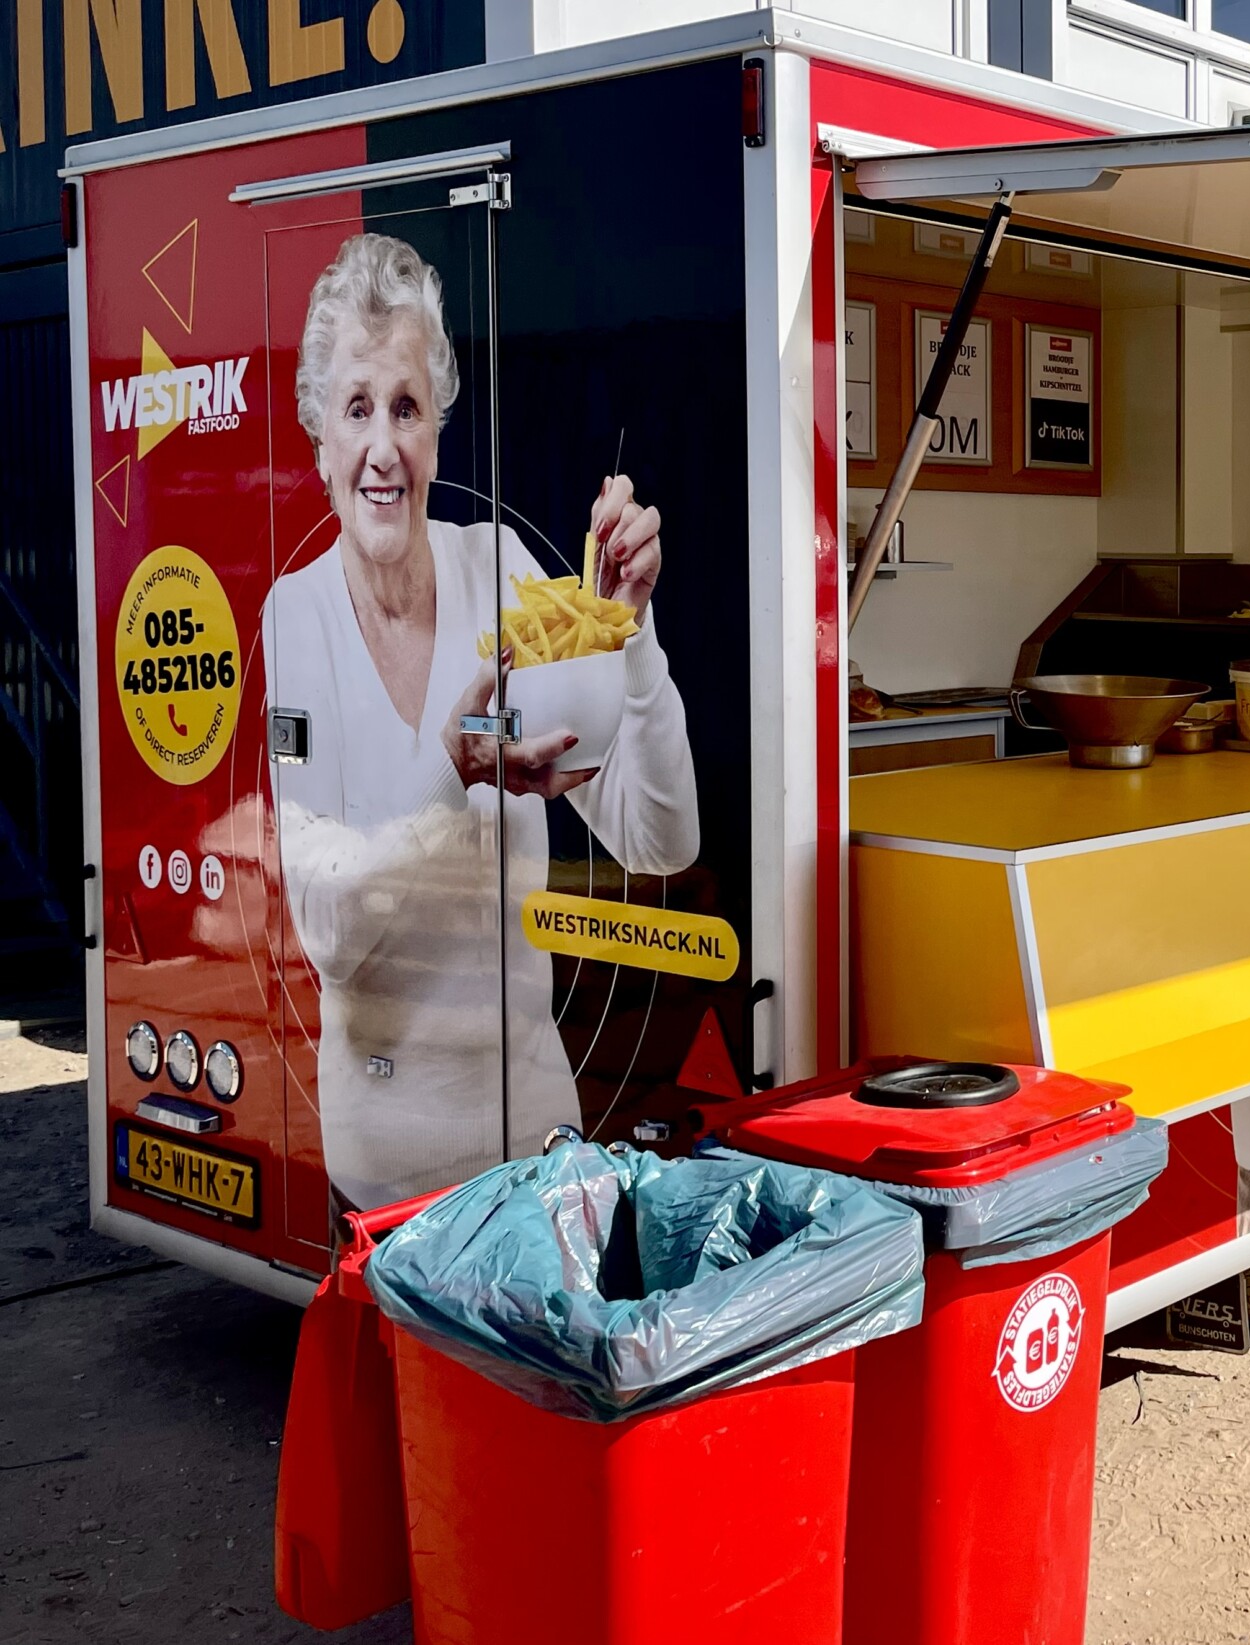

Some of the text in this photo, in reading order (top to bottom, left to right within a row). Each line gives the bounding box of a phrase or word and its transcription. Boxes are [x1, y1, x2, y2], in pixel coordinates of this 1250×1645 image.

[101, 357, 249, 432] WESTRIK
[188, 414, 240, 435] FASTFOOD
[126, 565, 201, 635] MEER INFORMATIE
[144, 608, 205, 648] 085-
[123, 651, 236, 695] 4852186
[135, 703, 226, 766] OF DIRECT RESERVEREN
[533, 908, 726, 960] WESTRIKSNACK.NL
[136, 1140, 245, 1207] 43-WHK-7
[1005, 1279, 1077, 1341] STATIEGELDBLIK
[1179, 1323, 1236, 1342] BUNSCHOTEN
[1003, 1341, 1076, 1406] STATIEGELDFLES
